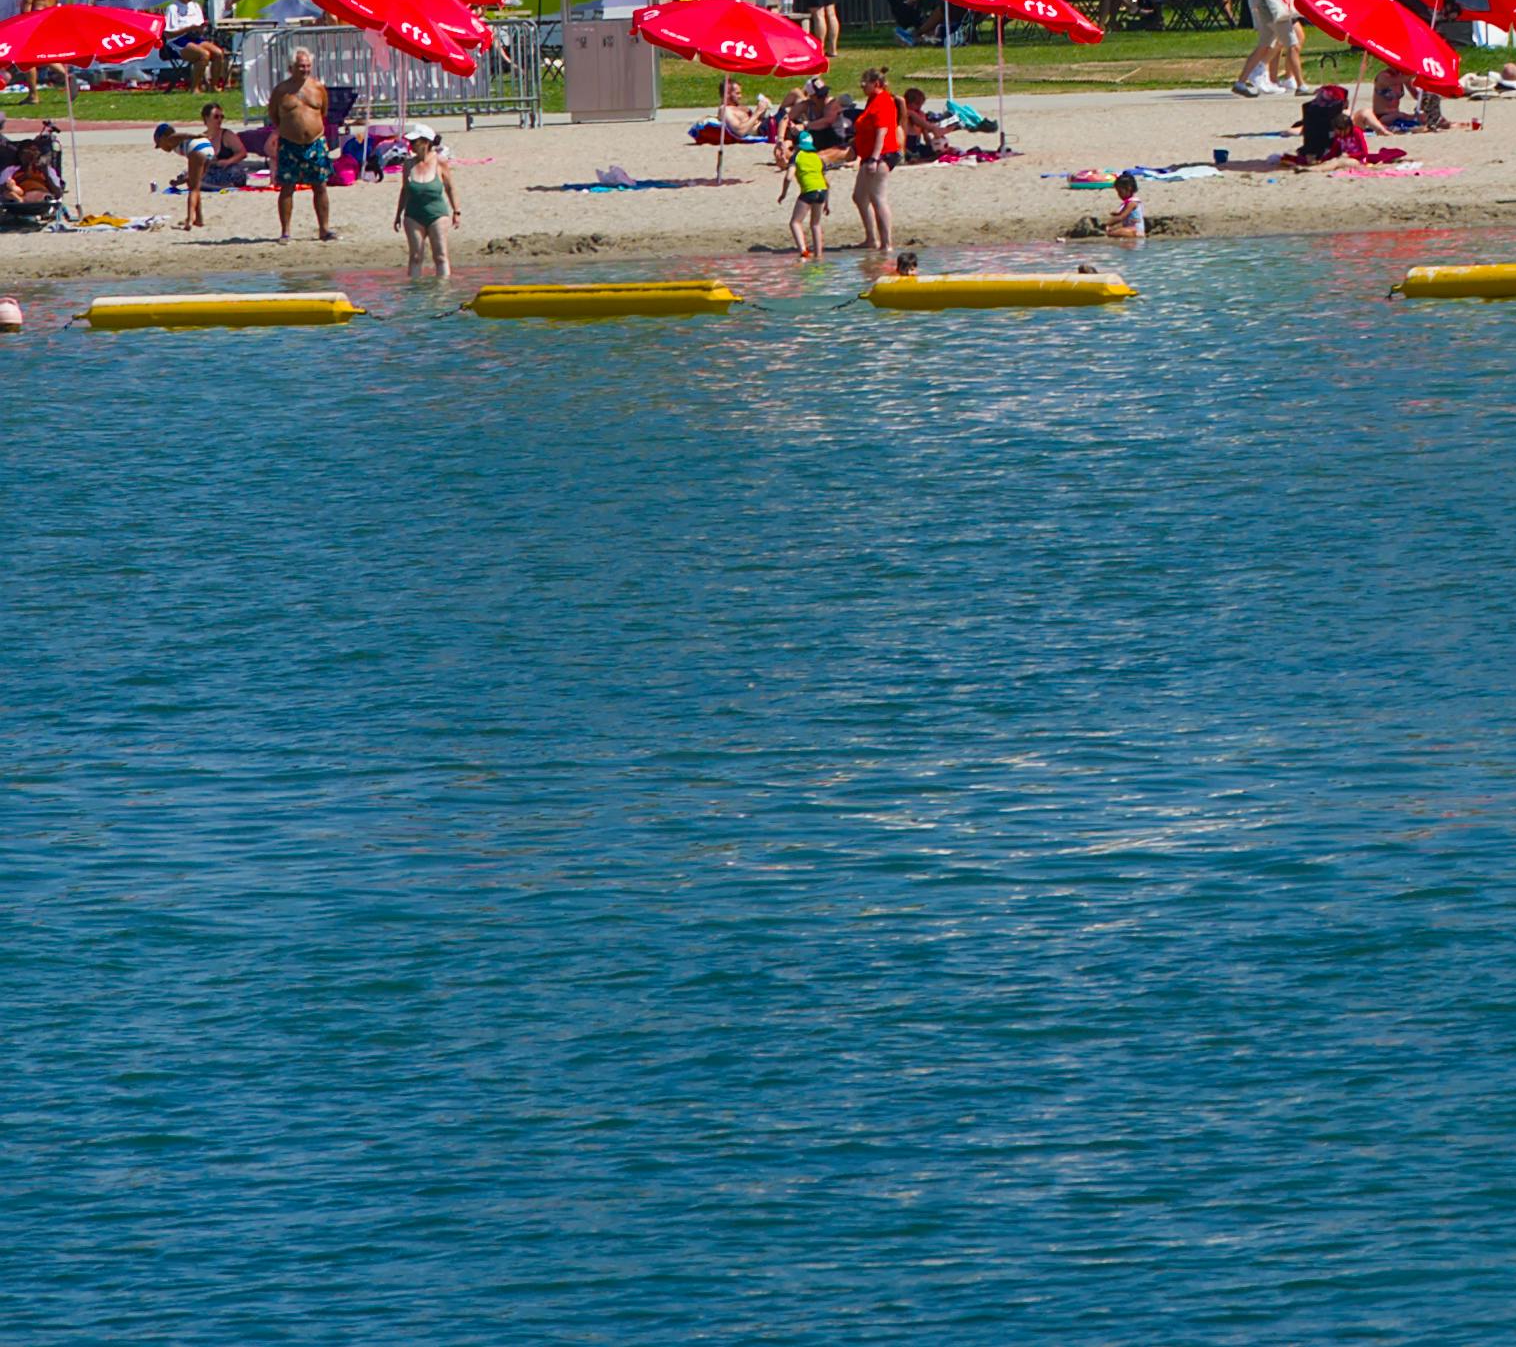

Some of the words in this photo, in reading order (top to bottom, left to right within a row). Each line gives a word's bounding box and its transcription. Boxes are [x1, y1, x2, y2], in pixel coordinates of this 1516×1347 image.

[1024, 0, 1058, 18] rts
[101, 31, 136, 51] rts
[401, 21, 431, 47] rts
[720, 40, 758, 60] rts
